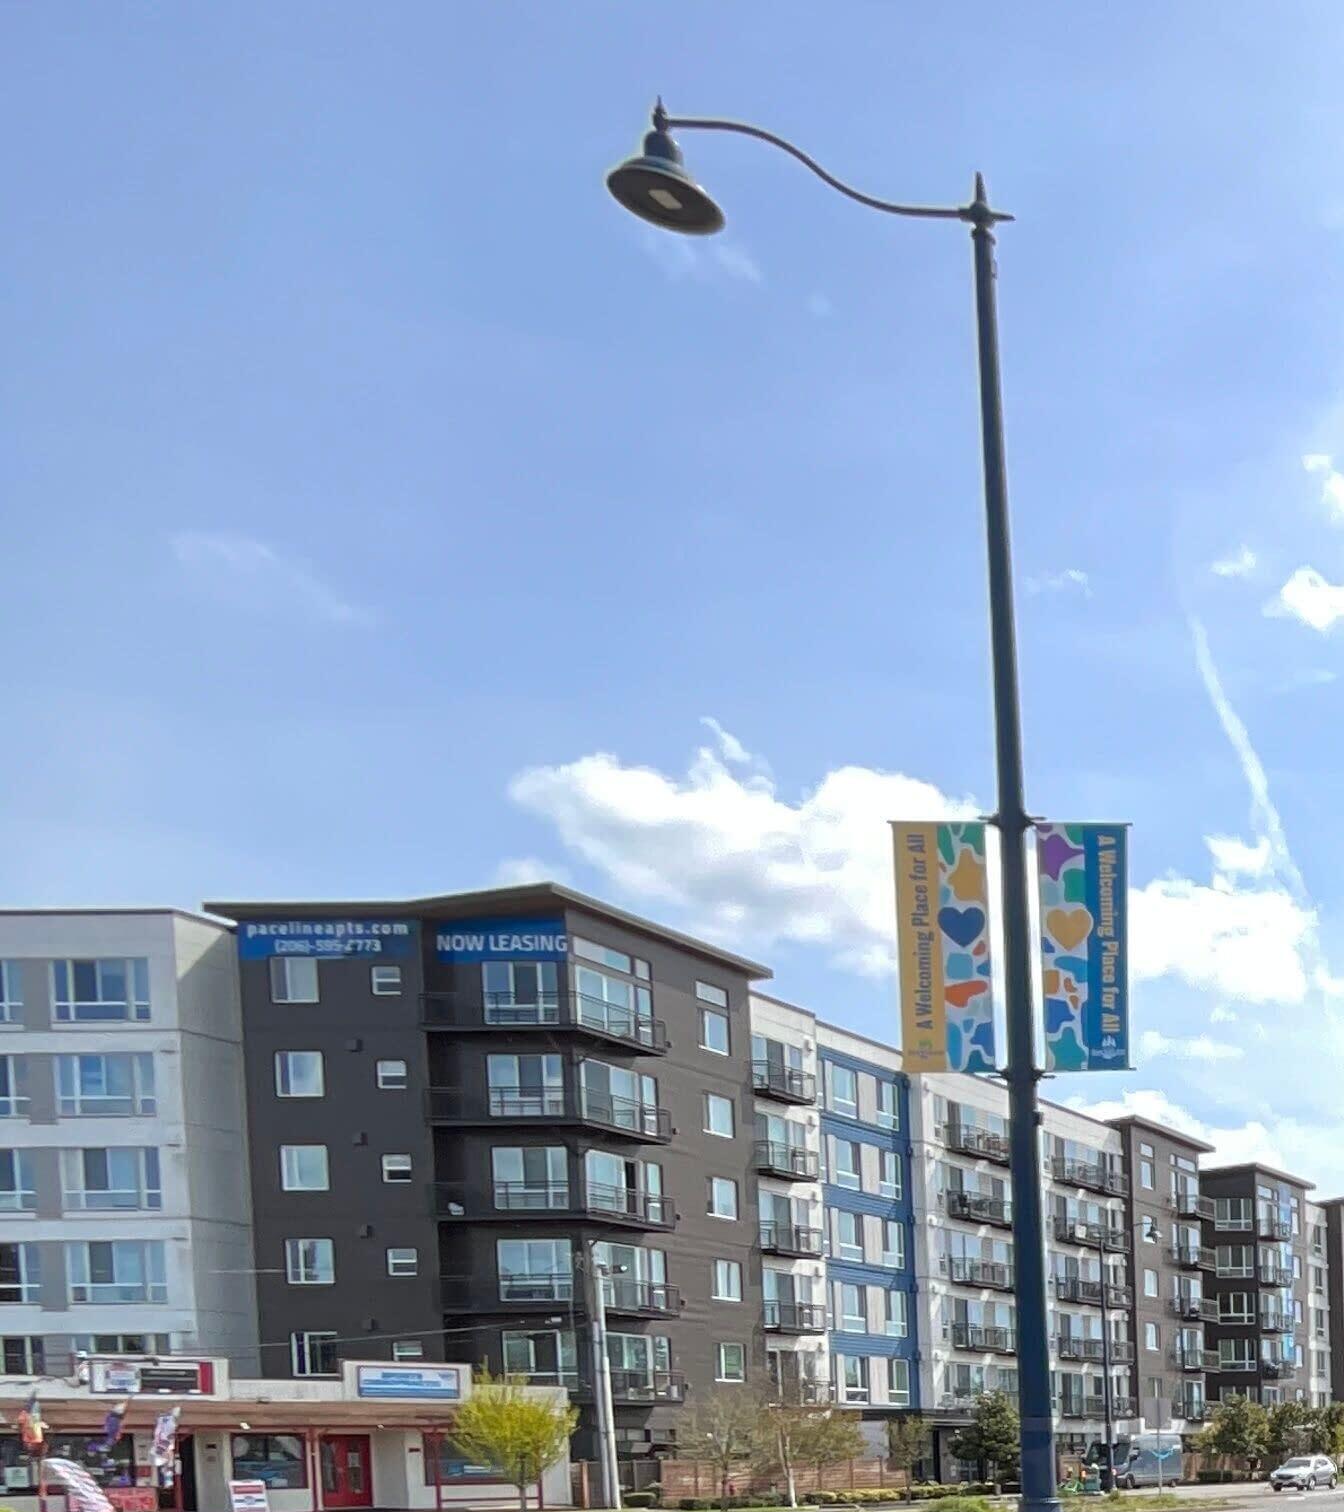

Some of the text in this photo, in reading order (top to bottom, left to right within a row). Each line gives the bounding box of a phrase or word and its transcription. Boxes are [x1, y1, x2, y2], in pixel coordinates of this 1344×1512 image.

[907, 834, 926, 853] All
[1097, 835, 1116, 846] A
[909, 857, 928, 880] for
[1097, 849, 1118, 937] Welcoming
[910, 886, 930, 927] Place
[246, 922, 409, 938] pacelineapts.com
[436, 933, 568, 952] NOW LEASING
[1101, 941, 1119, 983] Place
[913, 931, 935, 1016] Welcoming
[1102, 986, 1120, 1010] for
[916, 1019, 934, 1030] A
[1102, 1013, 1121, 1032] All
